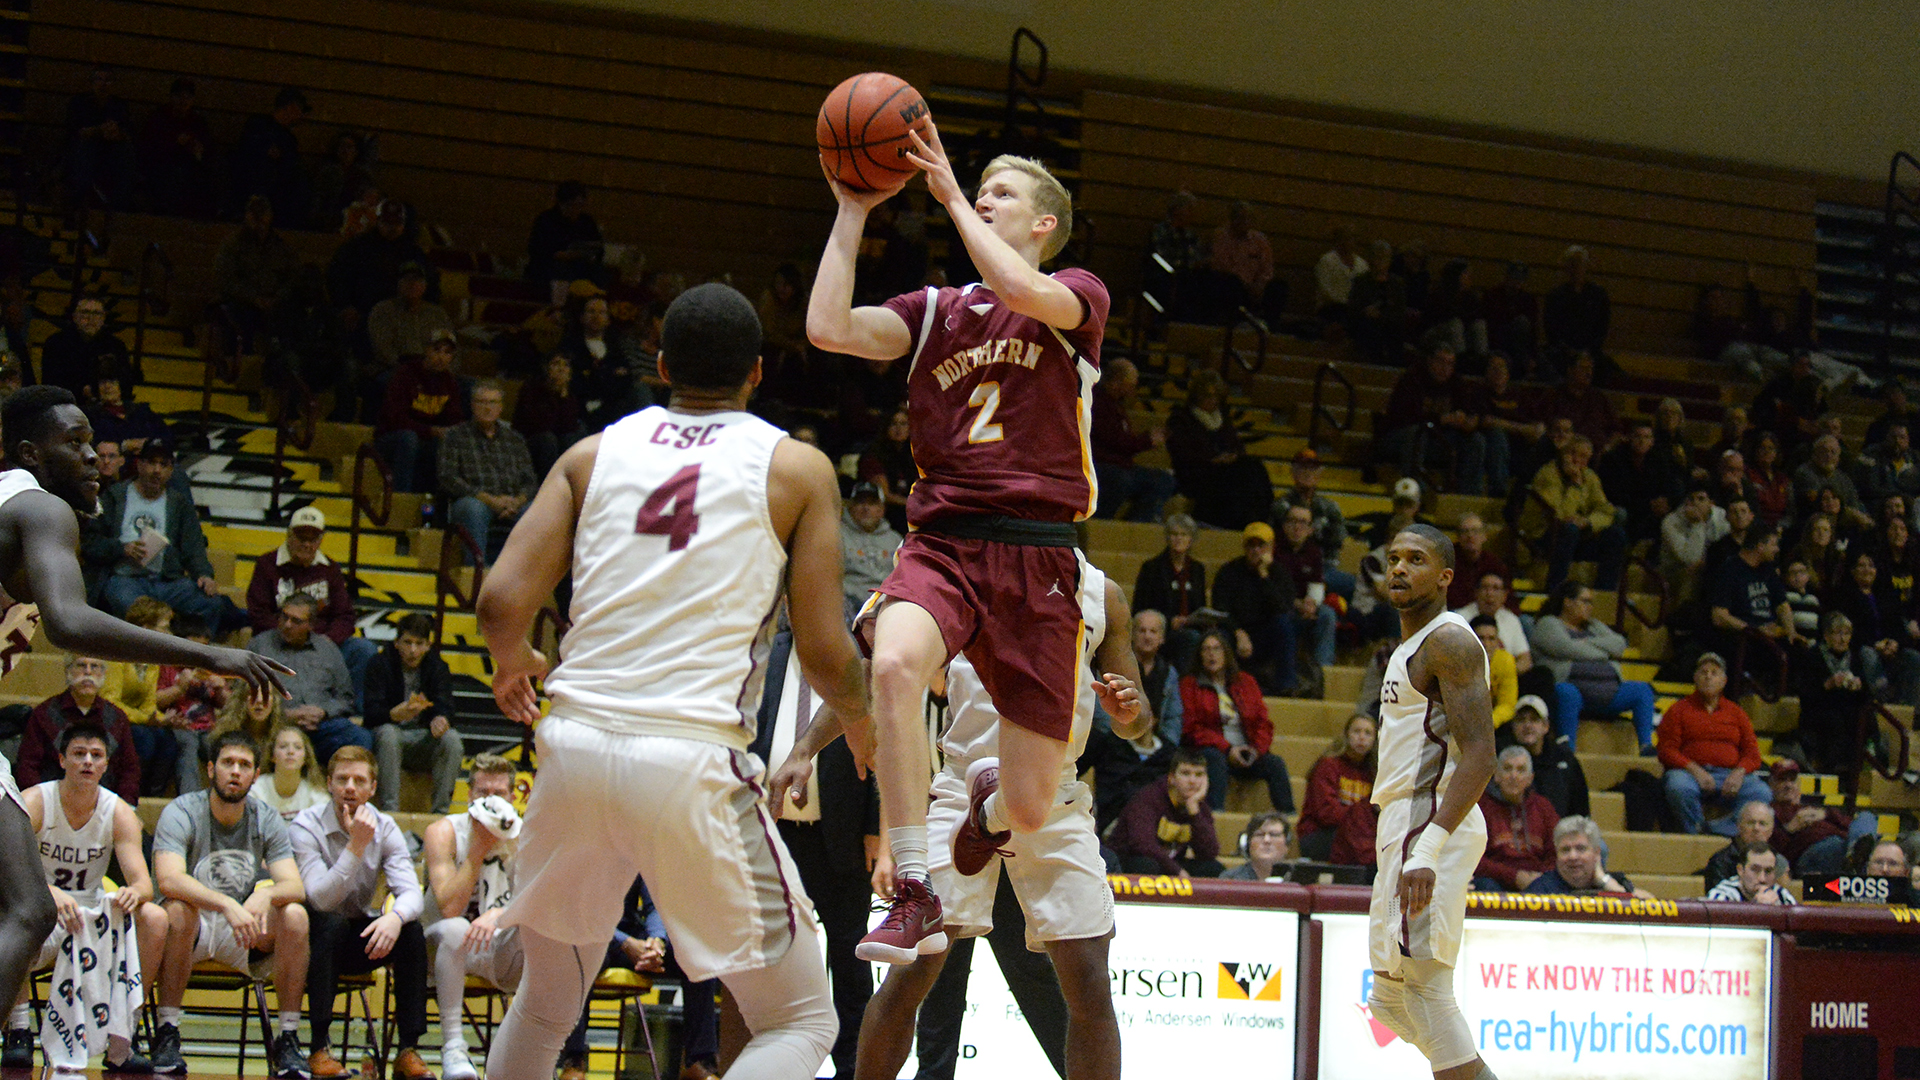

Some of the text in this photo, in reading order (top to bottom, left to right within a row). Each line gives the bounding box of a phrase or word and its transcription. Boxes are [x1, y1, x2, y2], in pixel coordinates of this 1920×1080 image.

[931, 337, 1044, 391] NORTHERN
[968, 380, 1004, 445] 2
[649, 422, 726, 450] CSC
[633, 461, 704, 552] 4
[54, 868, 88, 891] 21
[1839, 876, 1889, 898] POSS
[1480, 963, 1751, 997] WE KNOW THE NORTH!
[1145, 1009, 1211, 1026] Andersen
[1222, 1012, 1285, 1030] Windows
[1811, 1001, 1868, 1029] HOME
[1480, 1010, 1748, 1063] rea-hybrids.com
